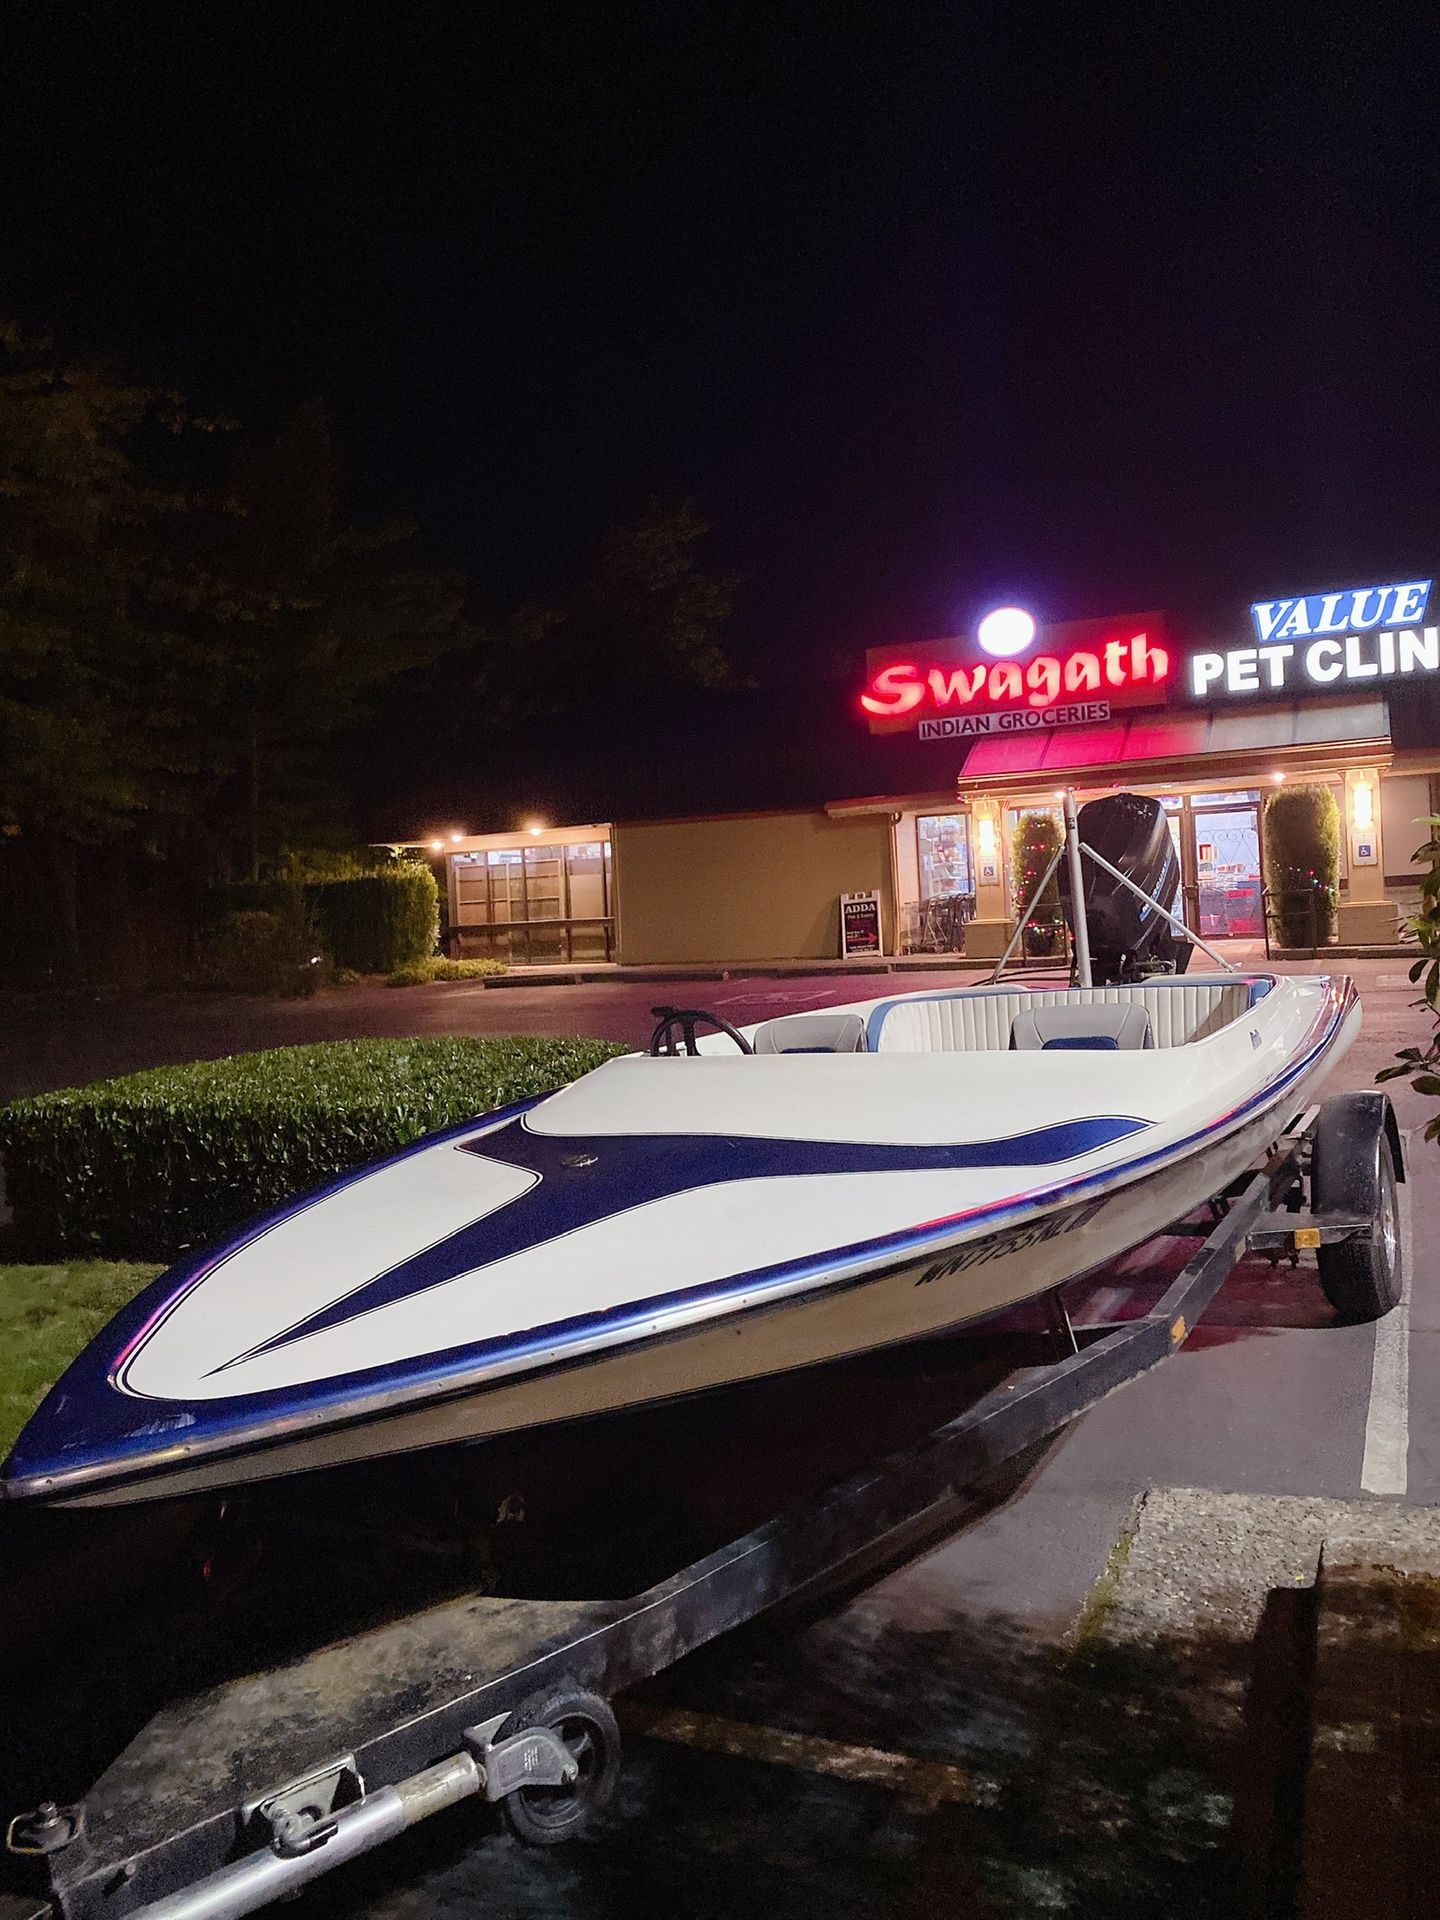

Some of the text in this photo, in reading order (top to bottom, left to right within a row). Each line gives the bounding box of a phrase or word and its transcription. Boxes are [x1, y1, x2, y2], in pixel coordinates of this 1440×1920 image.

[1254, 582, 1429, 641] VALUE
[861, 632, 1169, 715] Swagath
[1192, 626, 1439, 695] PET CLIN
[921, 703, 1109, 738] INDIAN GROCERIES
[845, 904, 876, 913] ADDA
